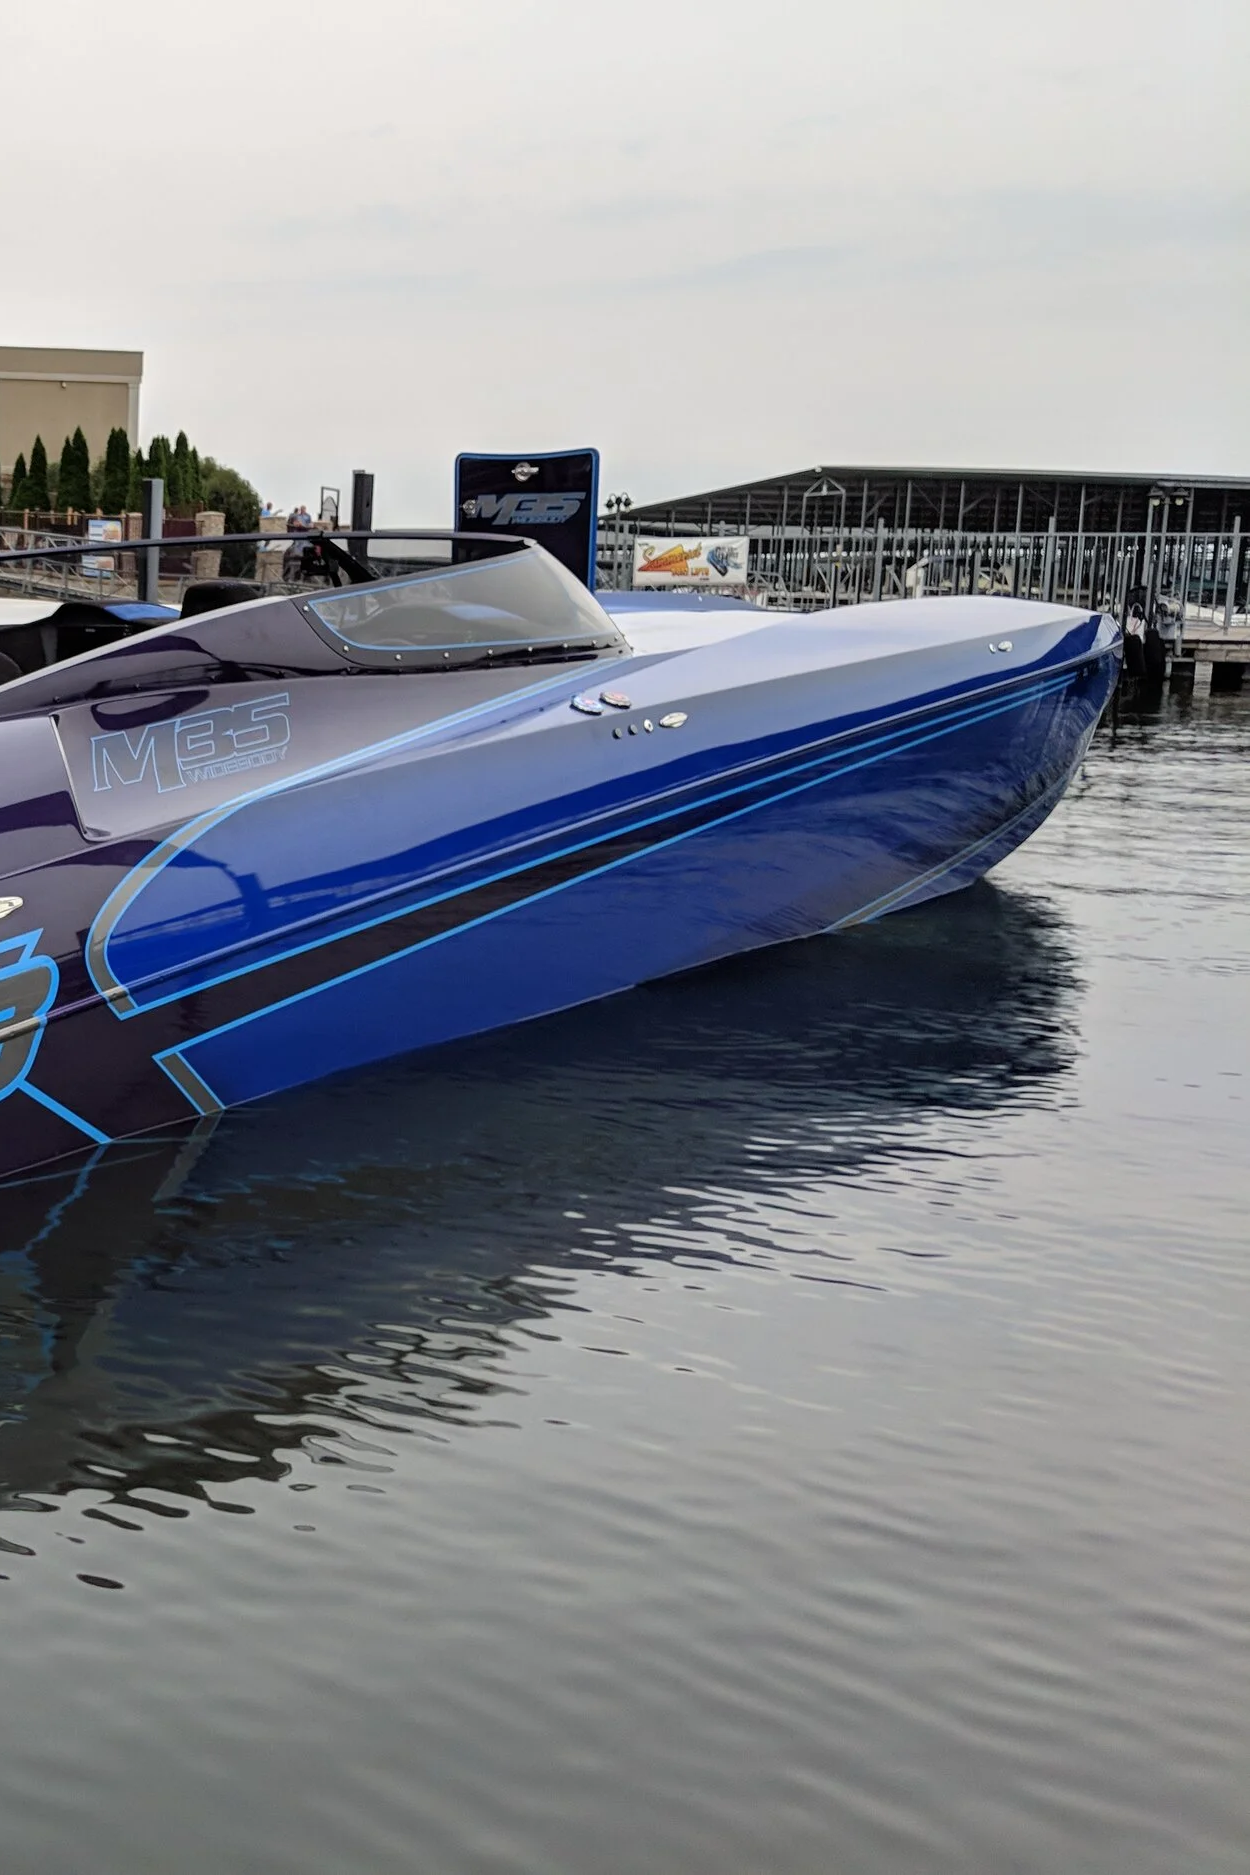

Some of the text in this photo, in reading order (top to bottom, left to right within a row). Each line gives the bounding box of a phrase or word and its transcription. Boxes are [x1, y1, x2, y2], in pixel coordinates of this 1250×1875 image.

[466, 491, 587, 525] M35
[89, 692, 291, 794] M35
[186, 745, 288, 783] WIDEBODY
